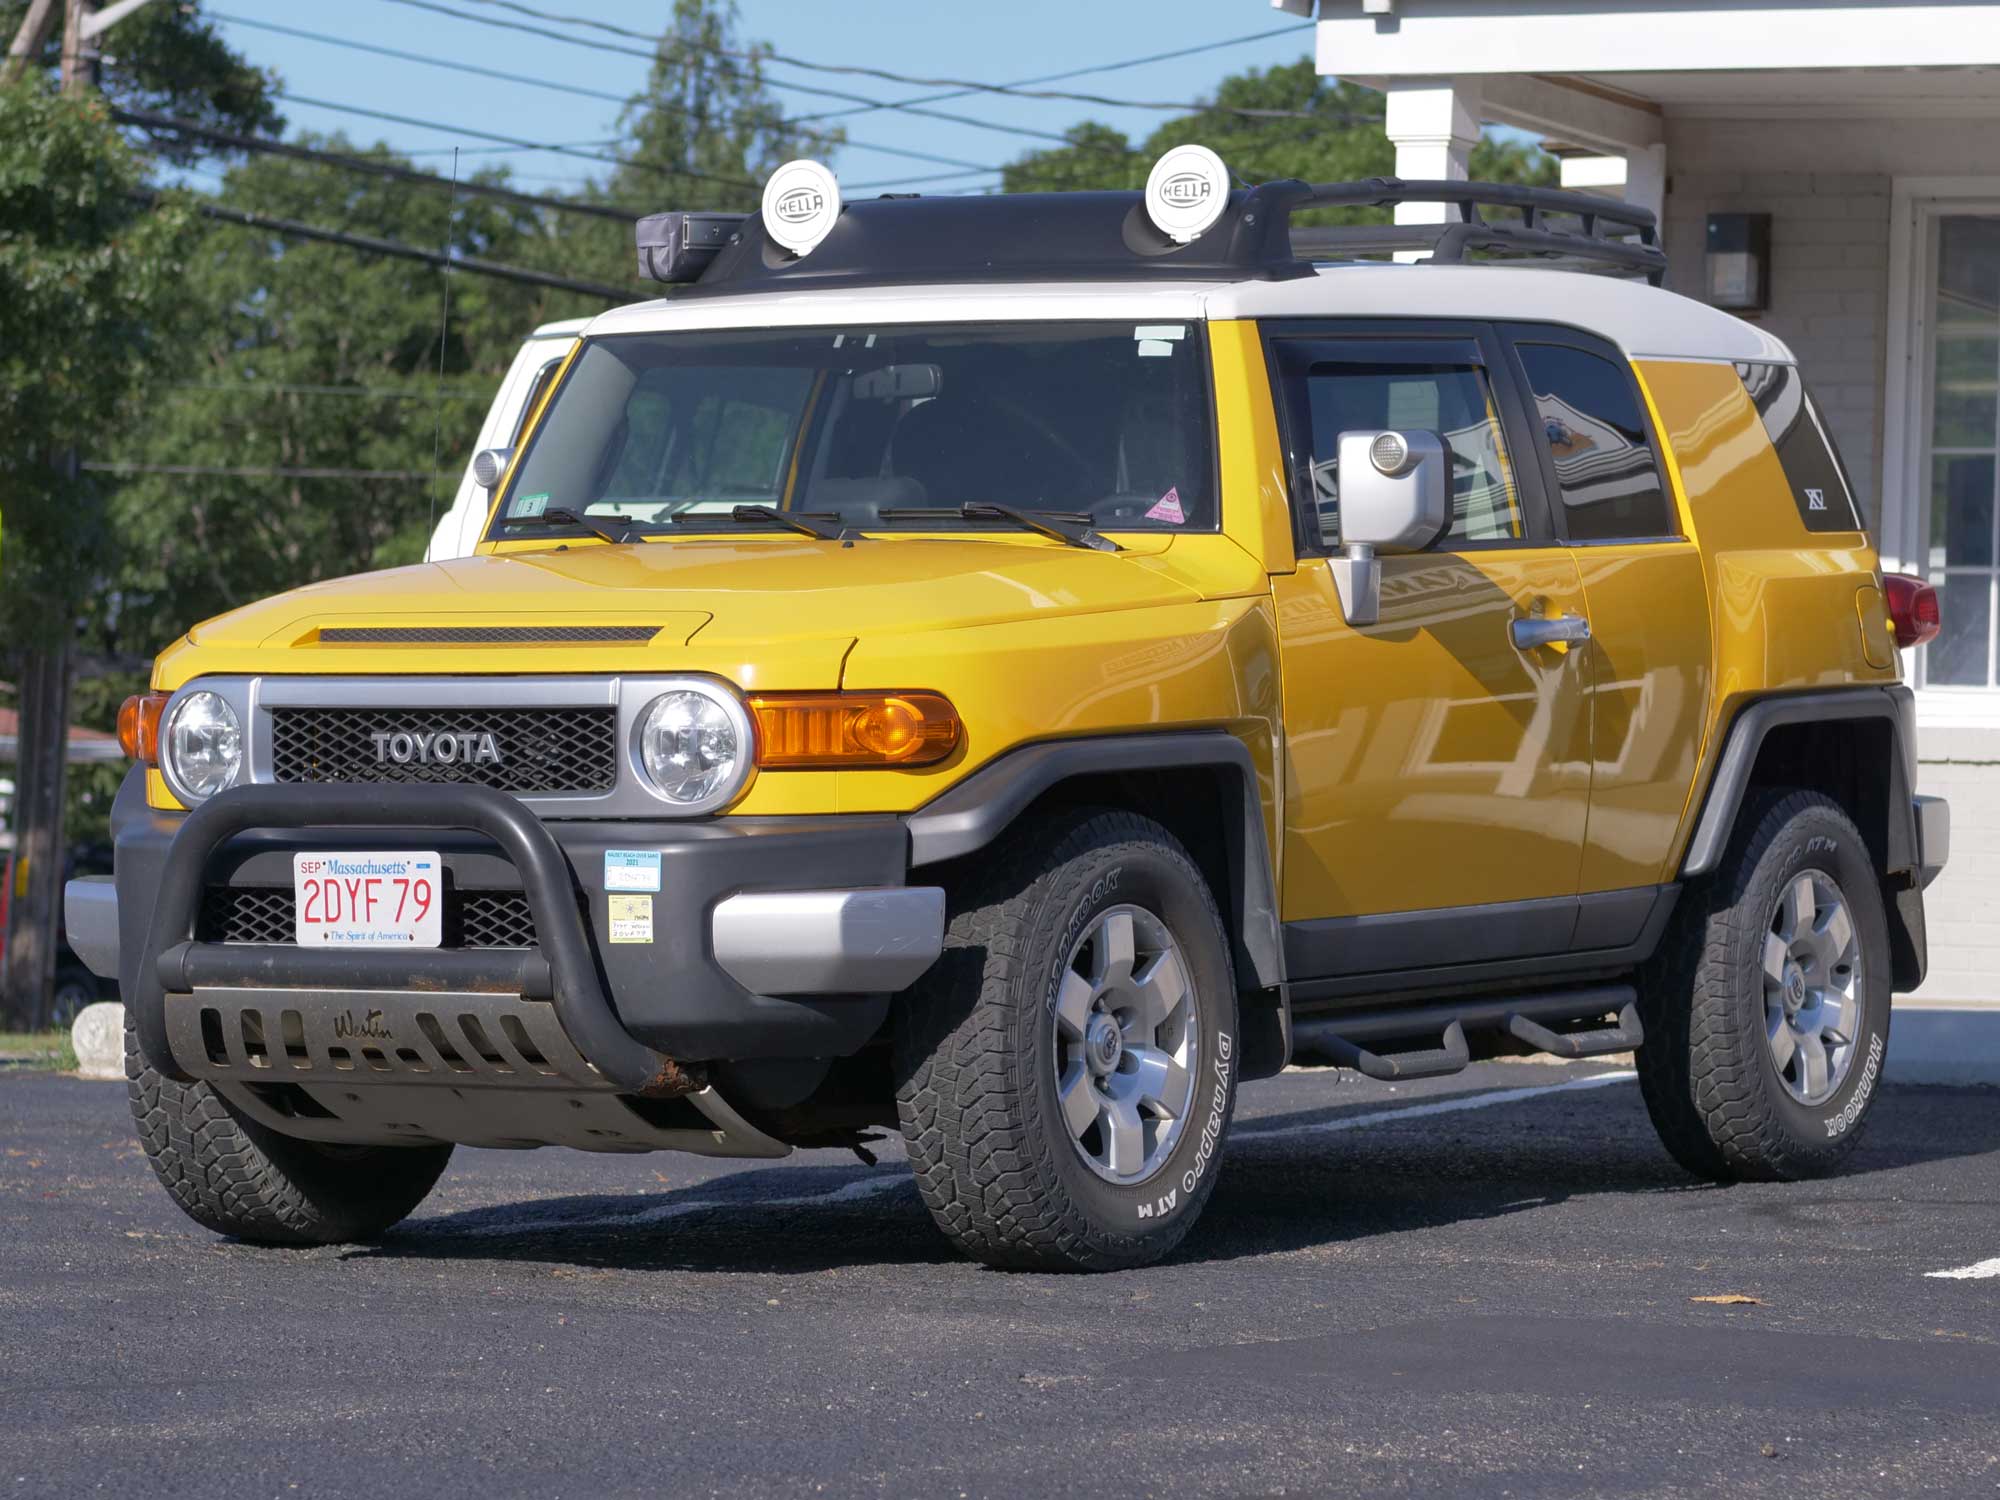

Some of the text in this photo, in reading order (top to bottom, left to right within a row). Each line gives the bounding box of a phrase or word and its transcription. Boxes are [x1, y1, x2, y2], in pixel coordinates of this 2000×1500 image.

[1164, 182, 1211, 197] HELLA
[779, 194, 824, 214] HELLA
[370, 732, 500, 764] TOYOTA
[301, 858, 407, 876] SEP Massachusetts
[303, 878, 432, 923] 2DYF 79
[331, 930, 408, 943] The Spirit of America
